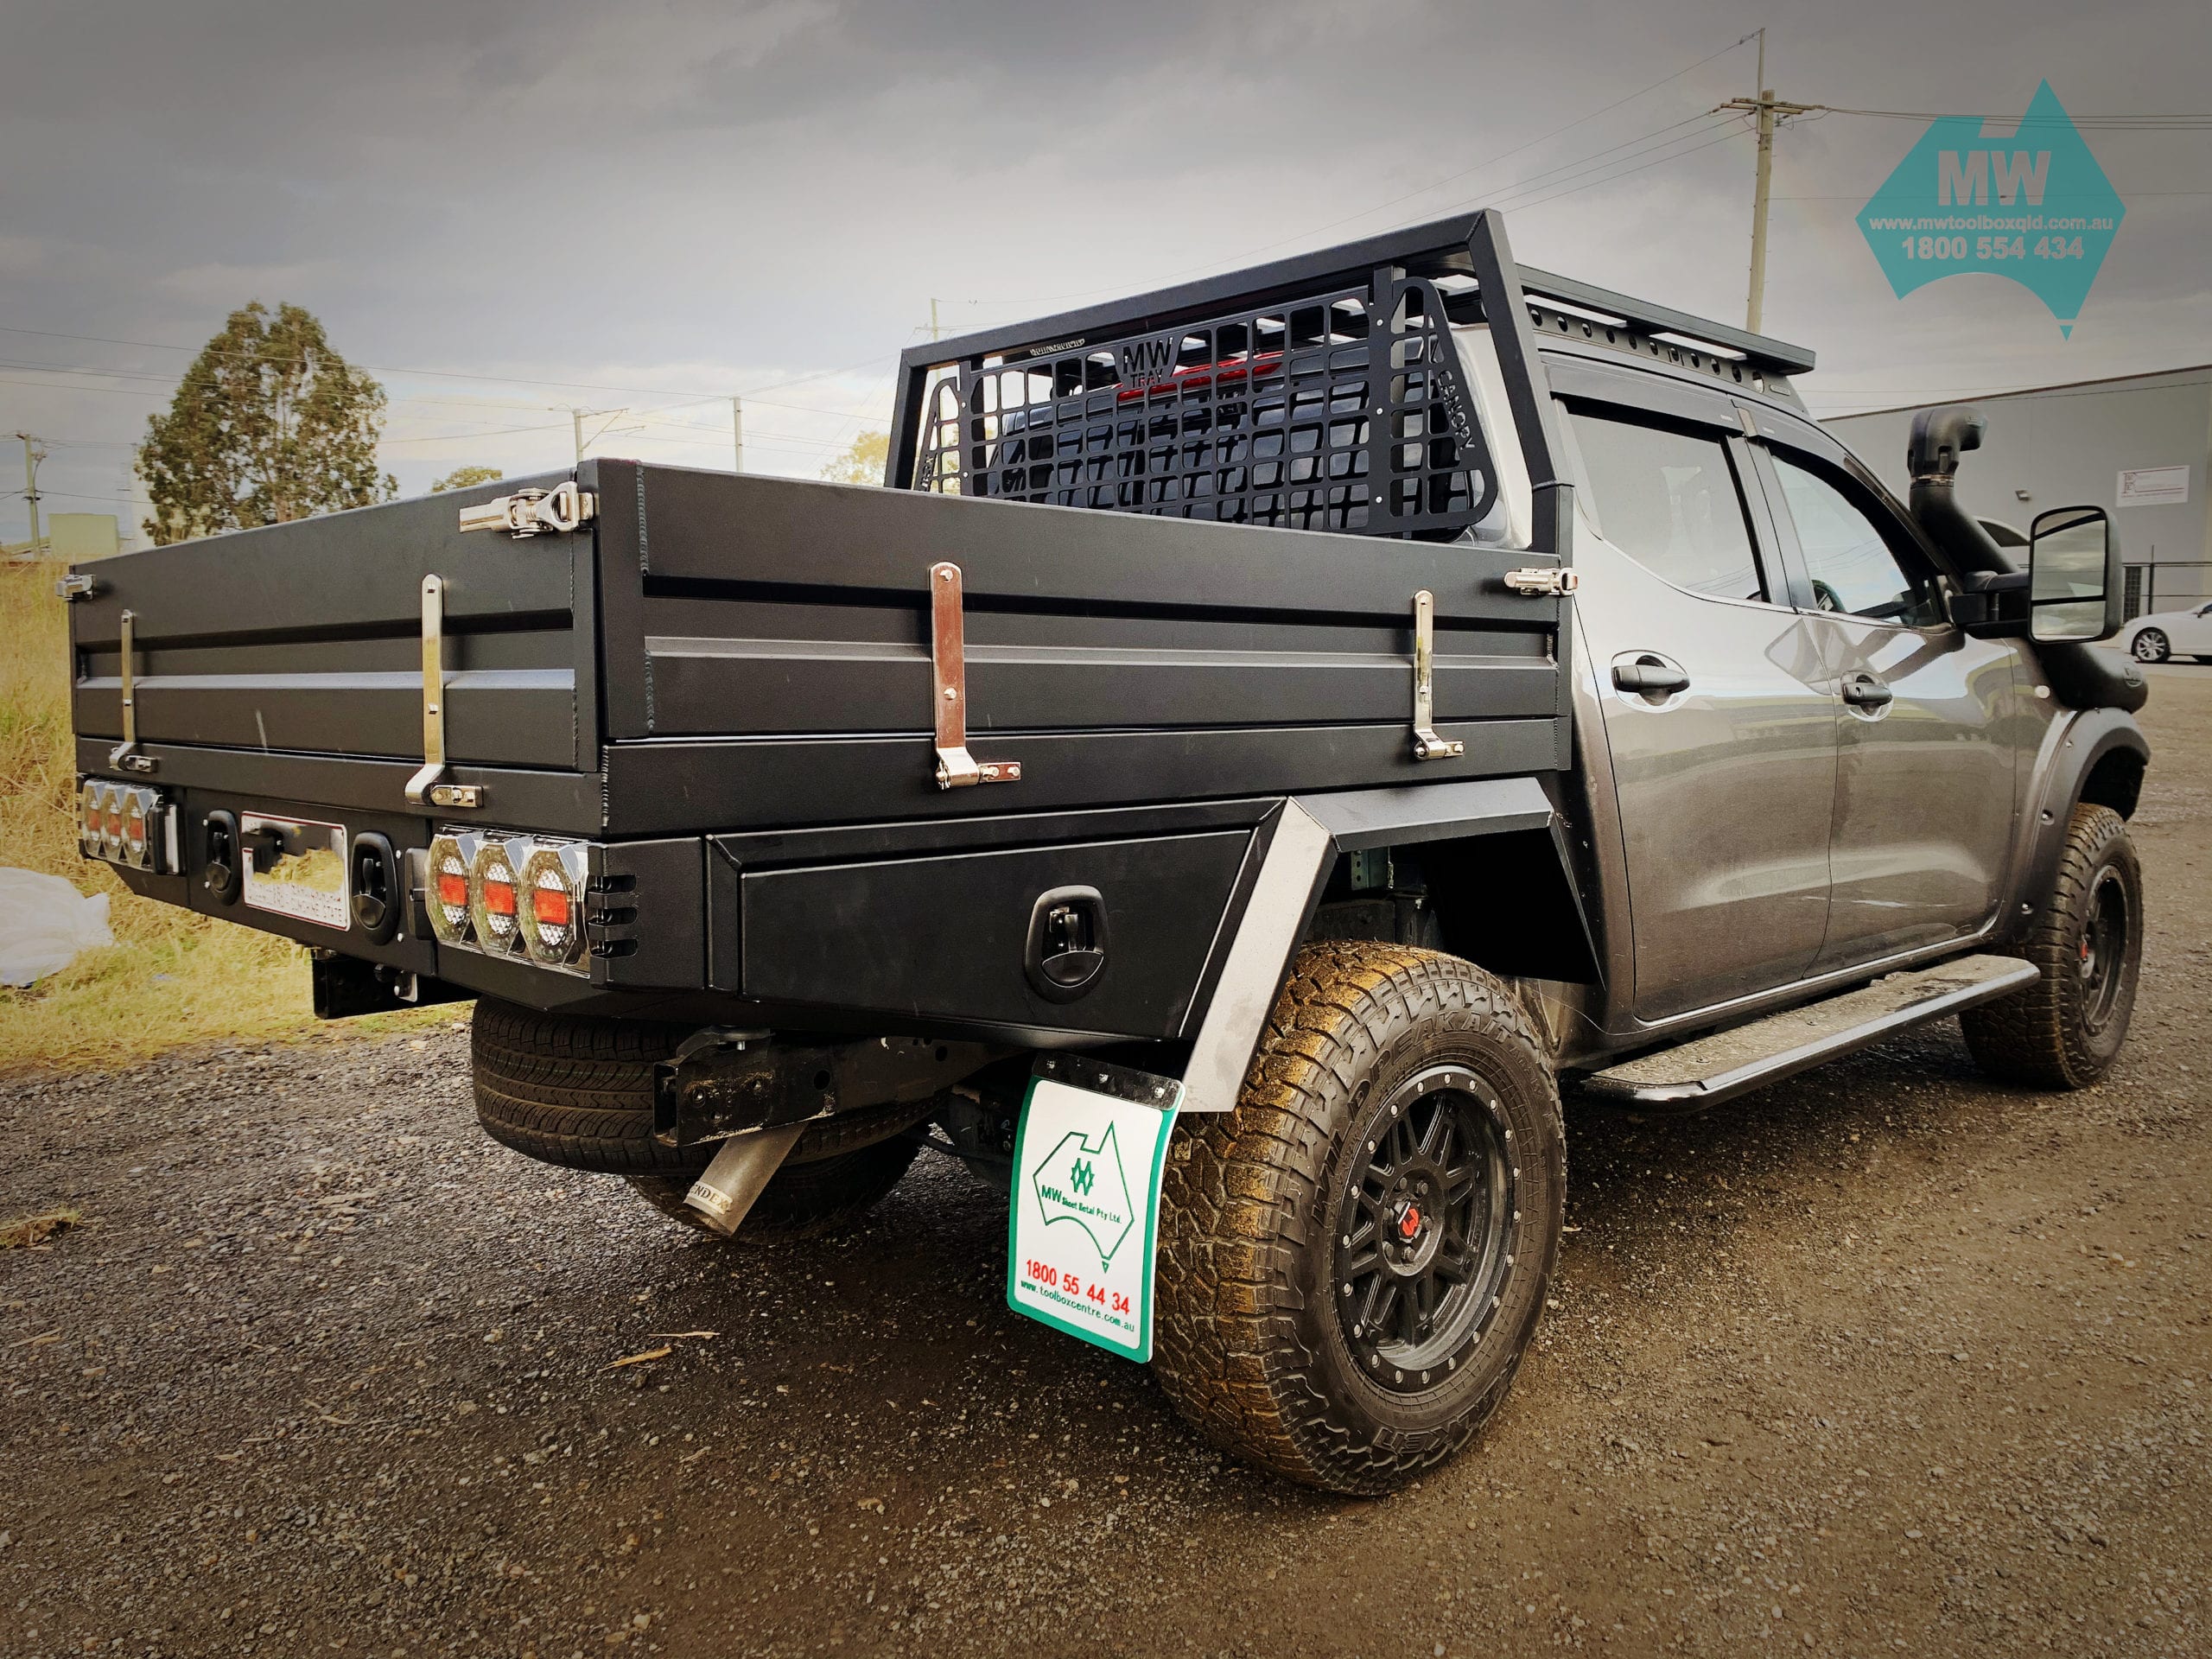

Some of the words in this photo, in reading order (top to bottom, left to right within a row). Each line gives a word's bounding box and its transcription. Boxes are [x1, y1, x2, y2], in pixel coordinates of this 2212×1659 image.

[1123, 337, 1173, 373] MW
[1130, 368, 1163, 388] TRAY
[1438, 370, 1475, 450] CANOPY
[1042, 1185, 1062, 1203] MW
[1096, 1208, 1108, 1220] Pty
[1020, 1280, 1135, 1332] www.toolboxcentre.com.au
[1027, 1259, 1057, 1287] 1800
[1062, 1273, 1079, 1295] 55
[1086, 1283, 1106, 1306] 44
[1111, 1293, 1130, 1315] 34
